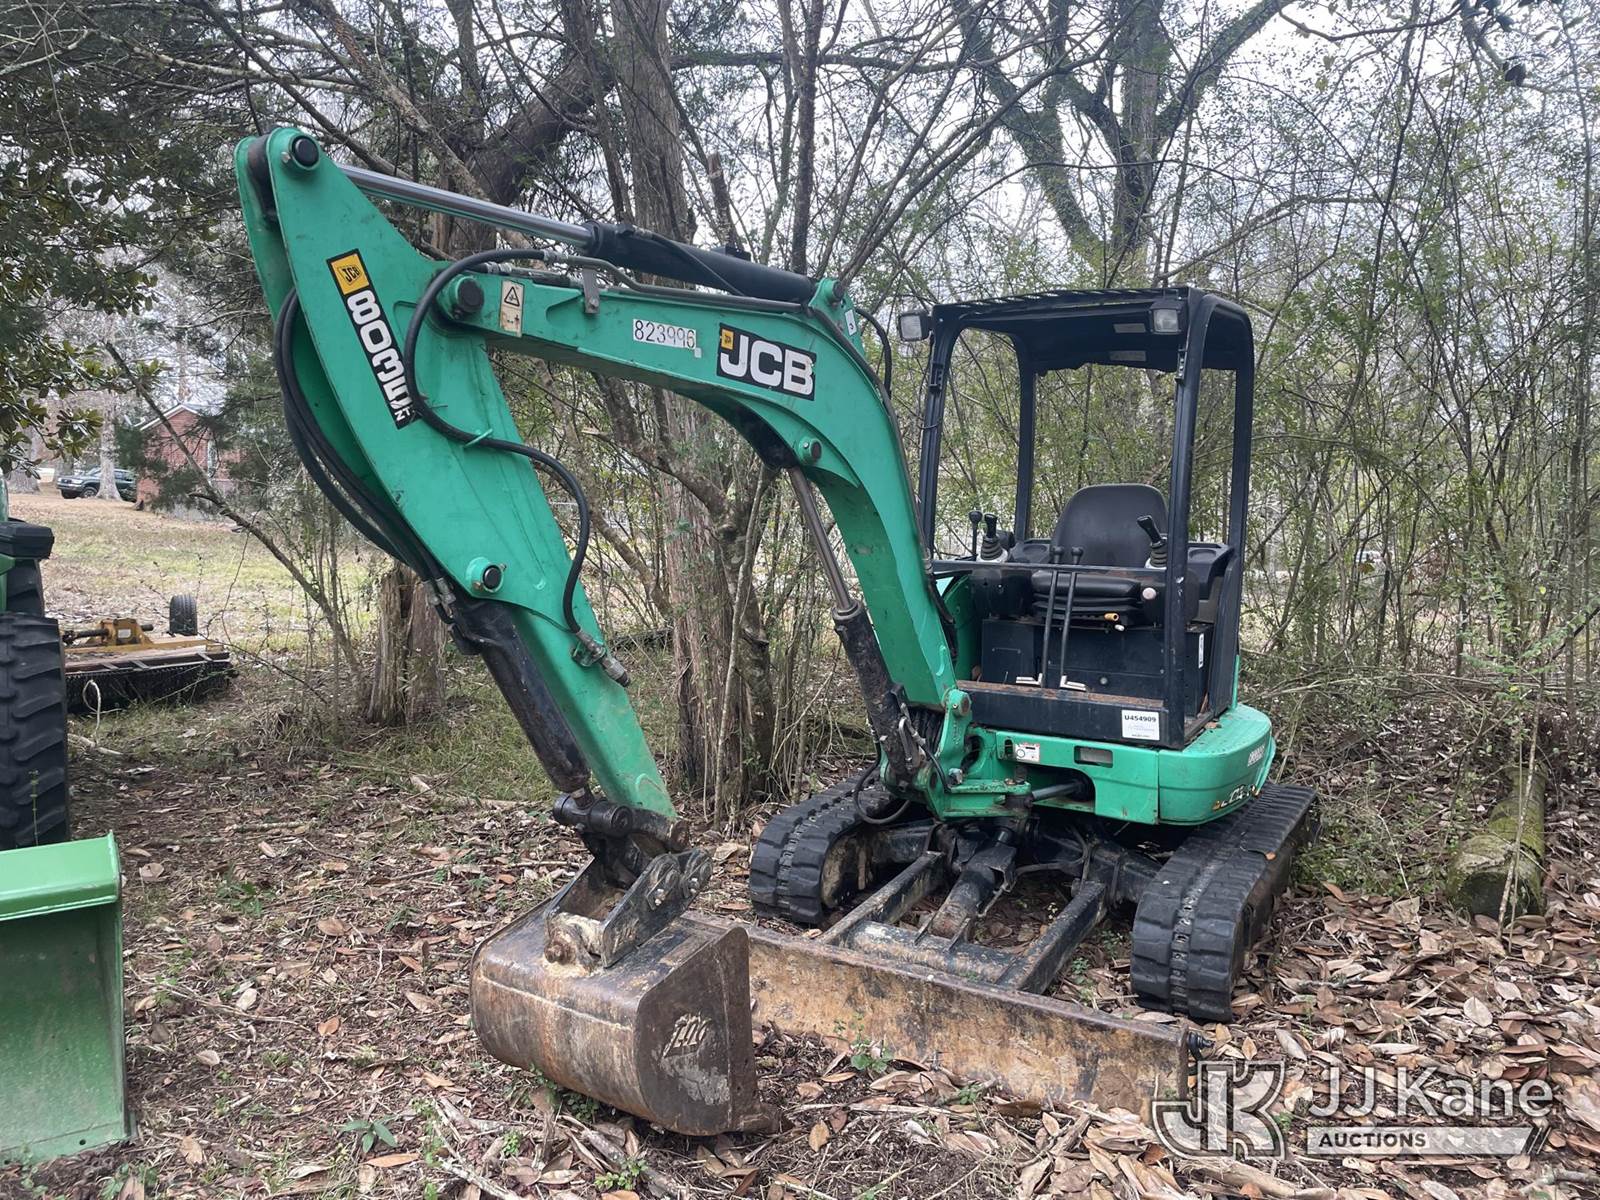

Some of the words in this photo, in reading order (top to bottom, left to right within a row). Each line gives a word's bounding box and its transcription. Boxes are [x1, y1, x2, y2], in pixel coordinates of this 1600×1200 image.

[341, 265, 361, 283] JCB
[634, 319, 695, 349] 823996
[346, 289, 413, 411] 8035
[720, 334, 813, 395] JCB
[1123, 714, 1157, 723] U454909
